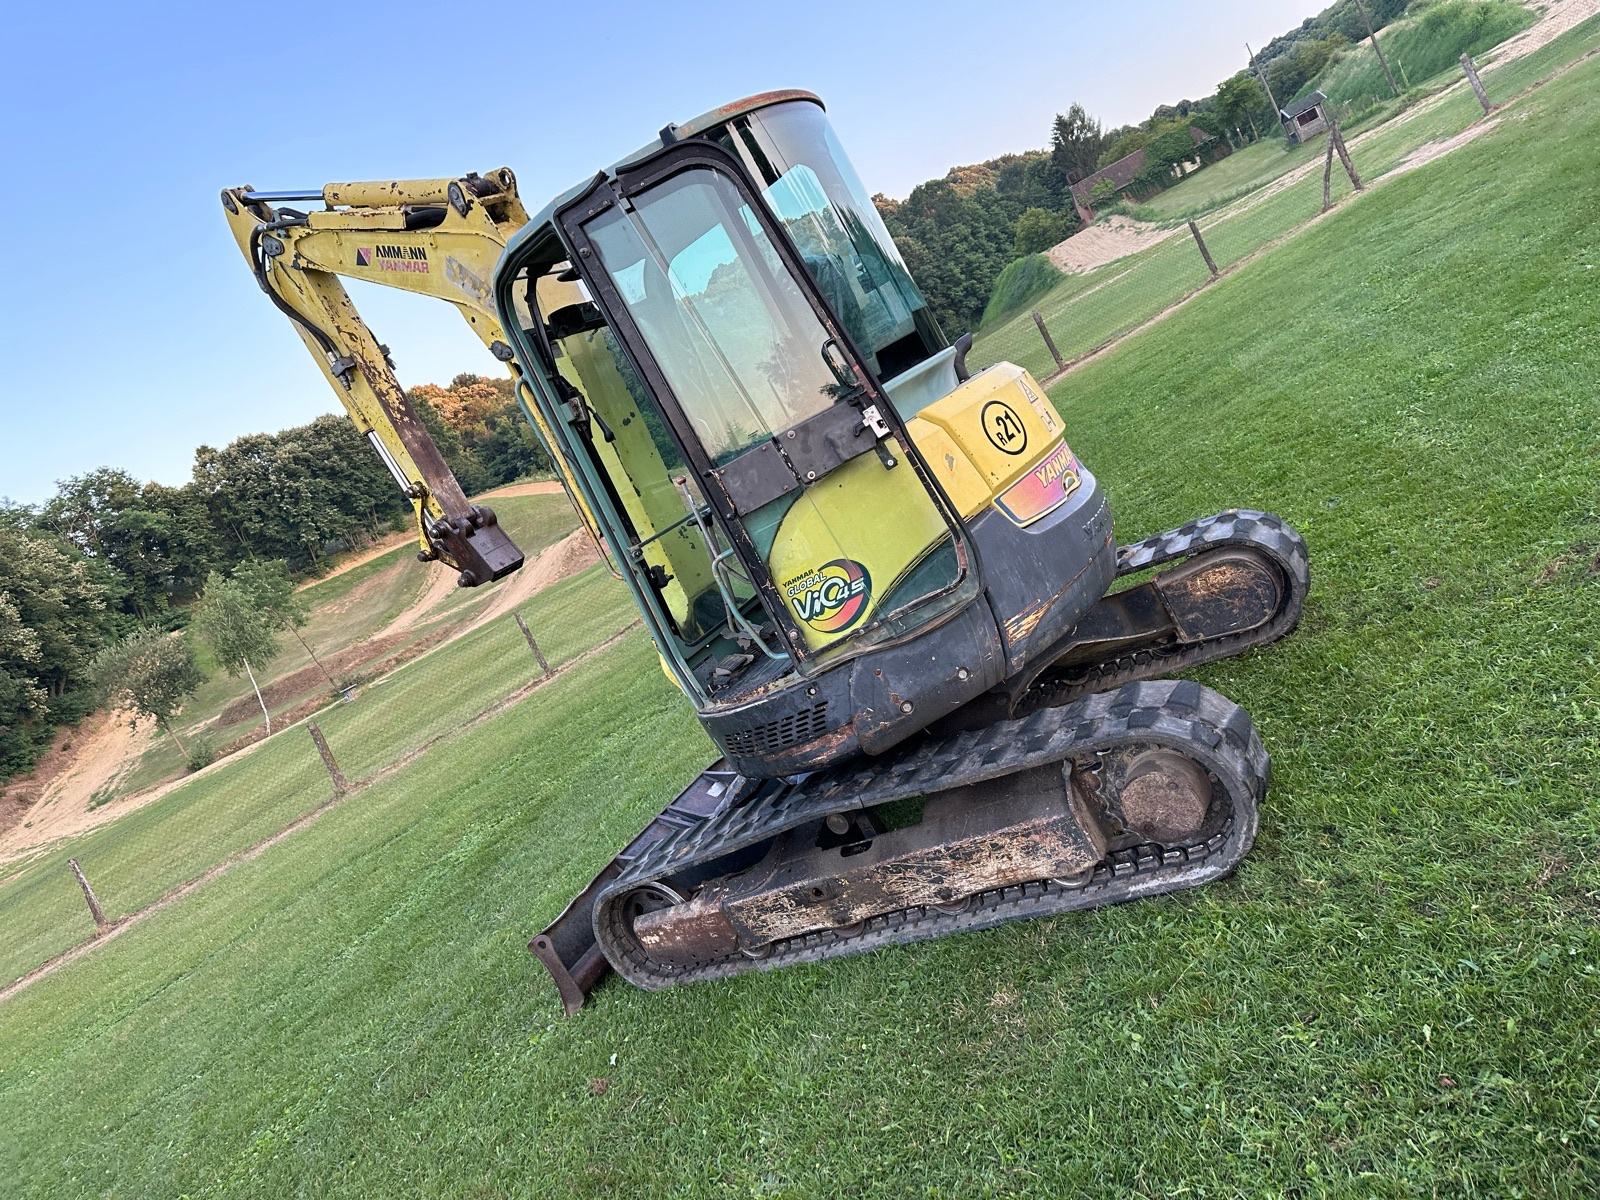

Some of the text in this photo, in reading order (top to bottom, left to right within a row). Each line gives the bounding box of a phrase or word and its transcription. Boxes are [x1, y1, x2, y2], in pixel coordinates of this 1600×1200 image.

[375, 245, 427, 260] AMMANN
[378, 260, 429, 273] YANMAR
[1034, 446, 1072, 488] YANMA
[783, 568, 814, 588] YANMAR
[787, 572, 827, 597] GLOBAL
